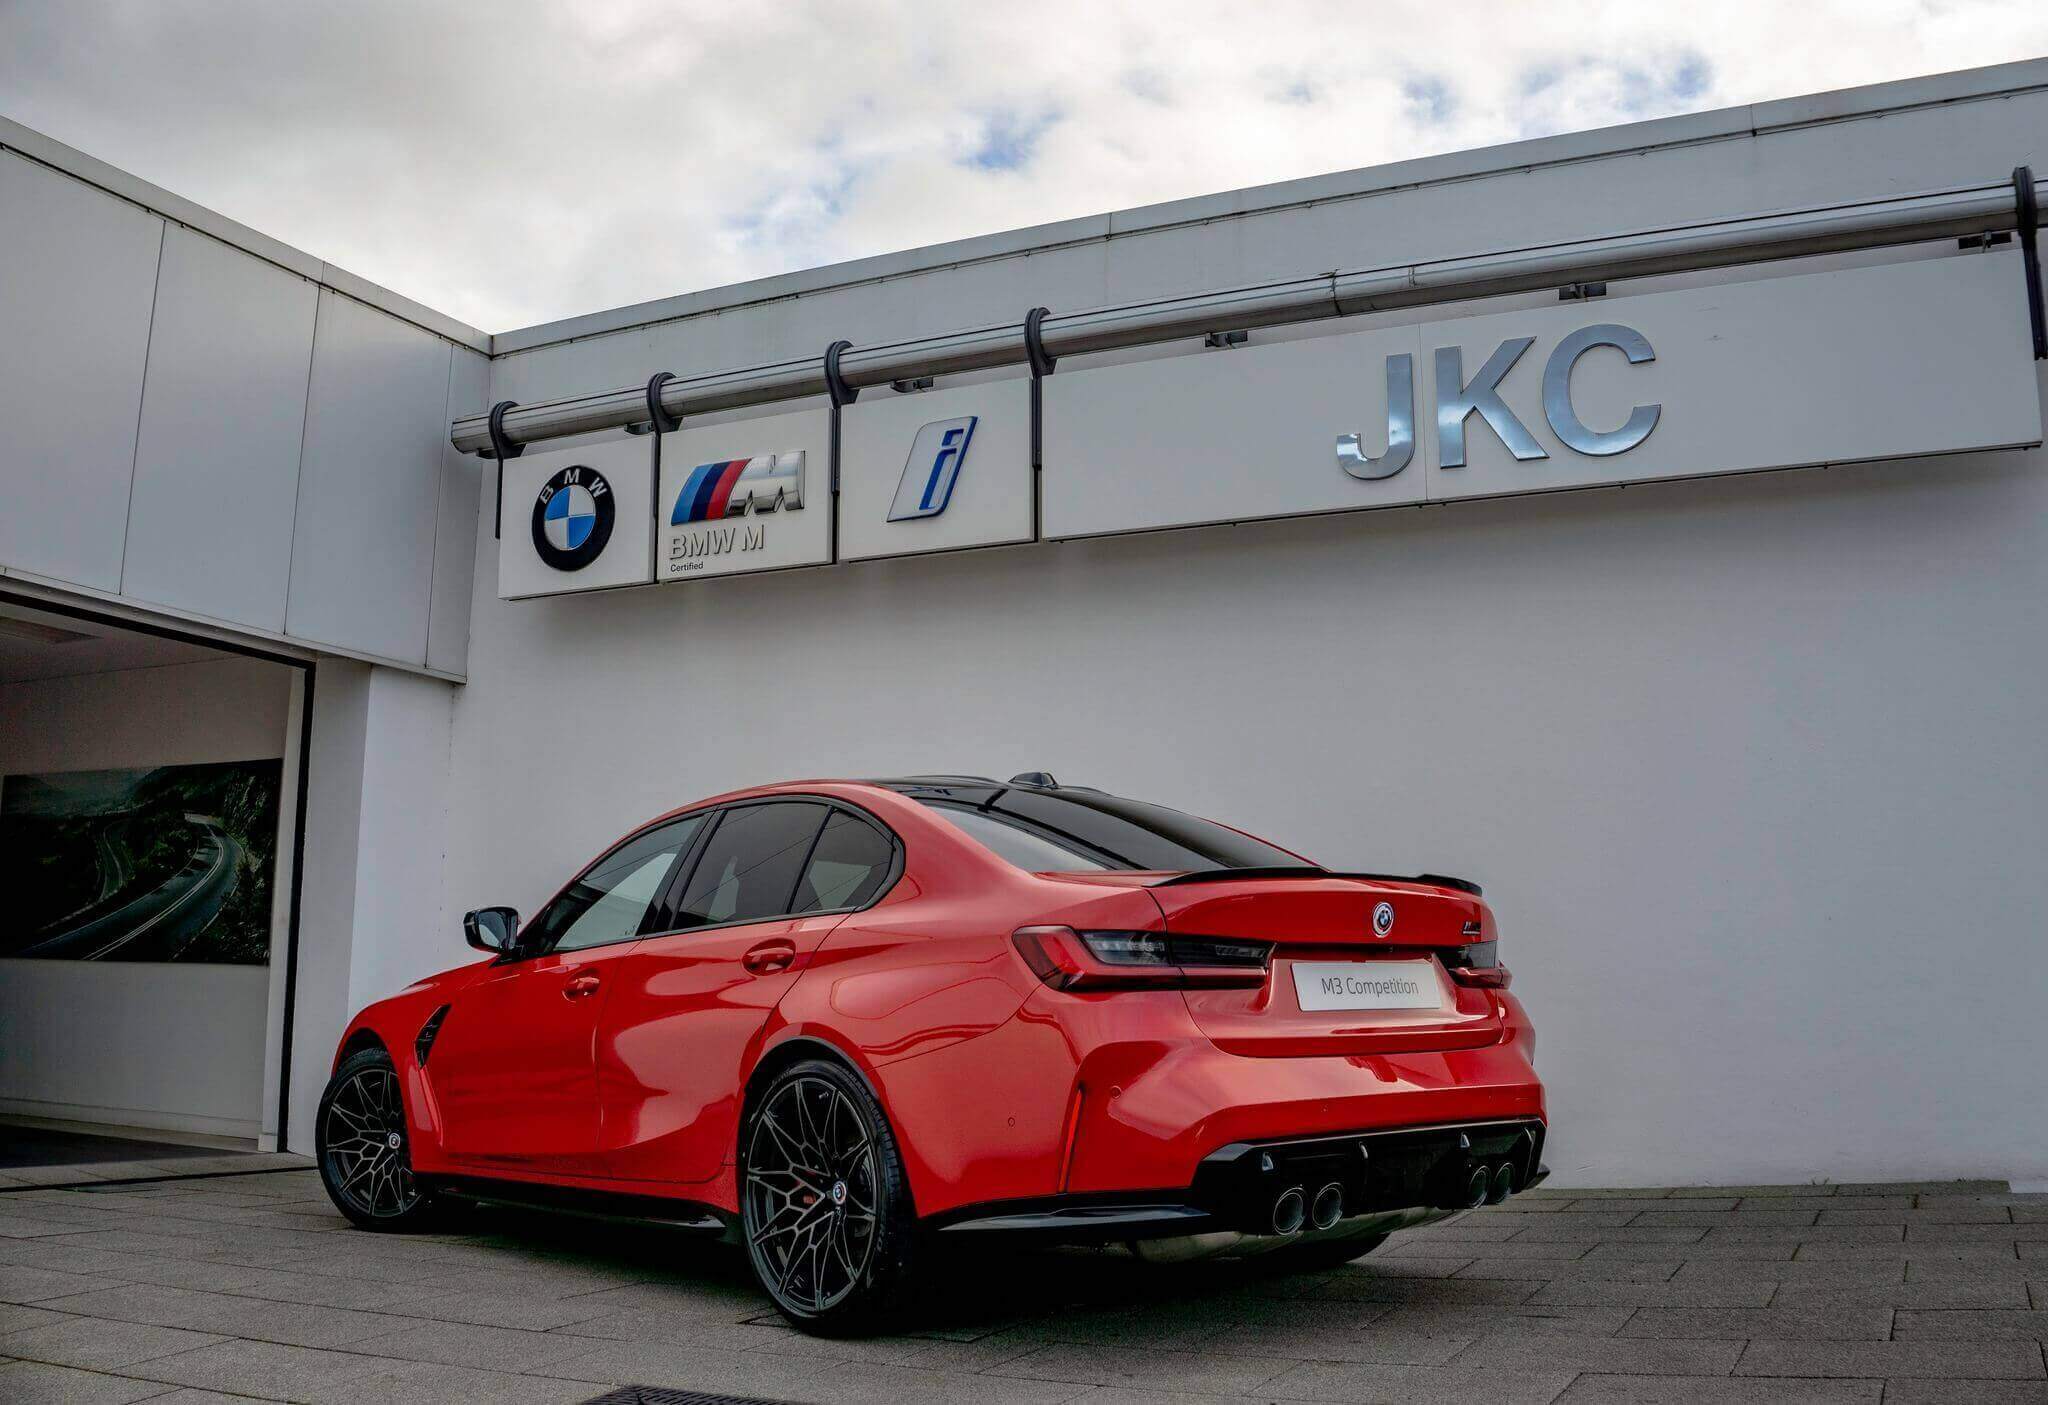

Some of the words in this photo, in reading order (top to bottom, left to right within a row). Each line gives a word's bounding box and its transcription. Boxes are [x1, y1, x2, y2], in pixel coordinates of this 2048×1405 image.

[1336, 323, 1662, 481] JKC
[540, 468, 608, 504] BMW
[669, 527, 736, 560] BMW
[741, 524, 765, 552] M
[670, 561, 704, 572] Certified
[1321, 977, 1343, 995] M3
[1346, 977, 1419, 998] Competition
